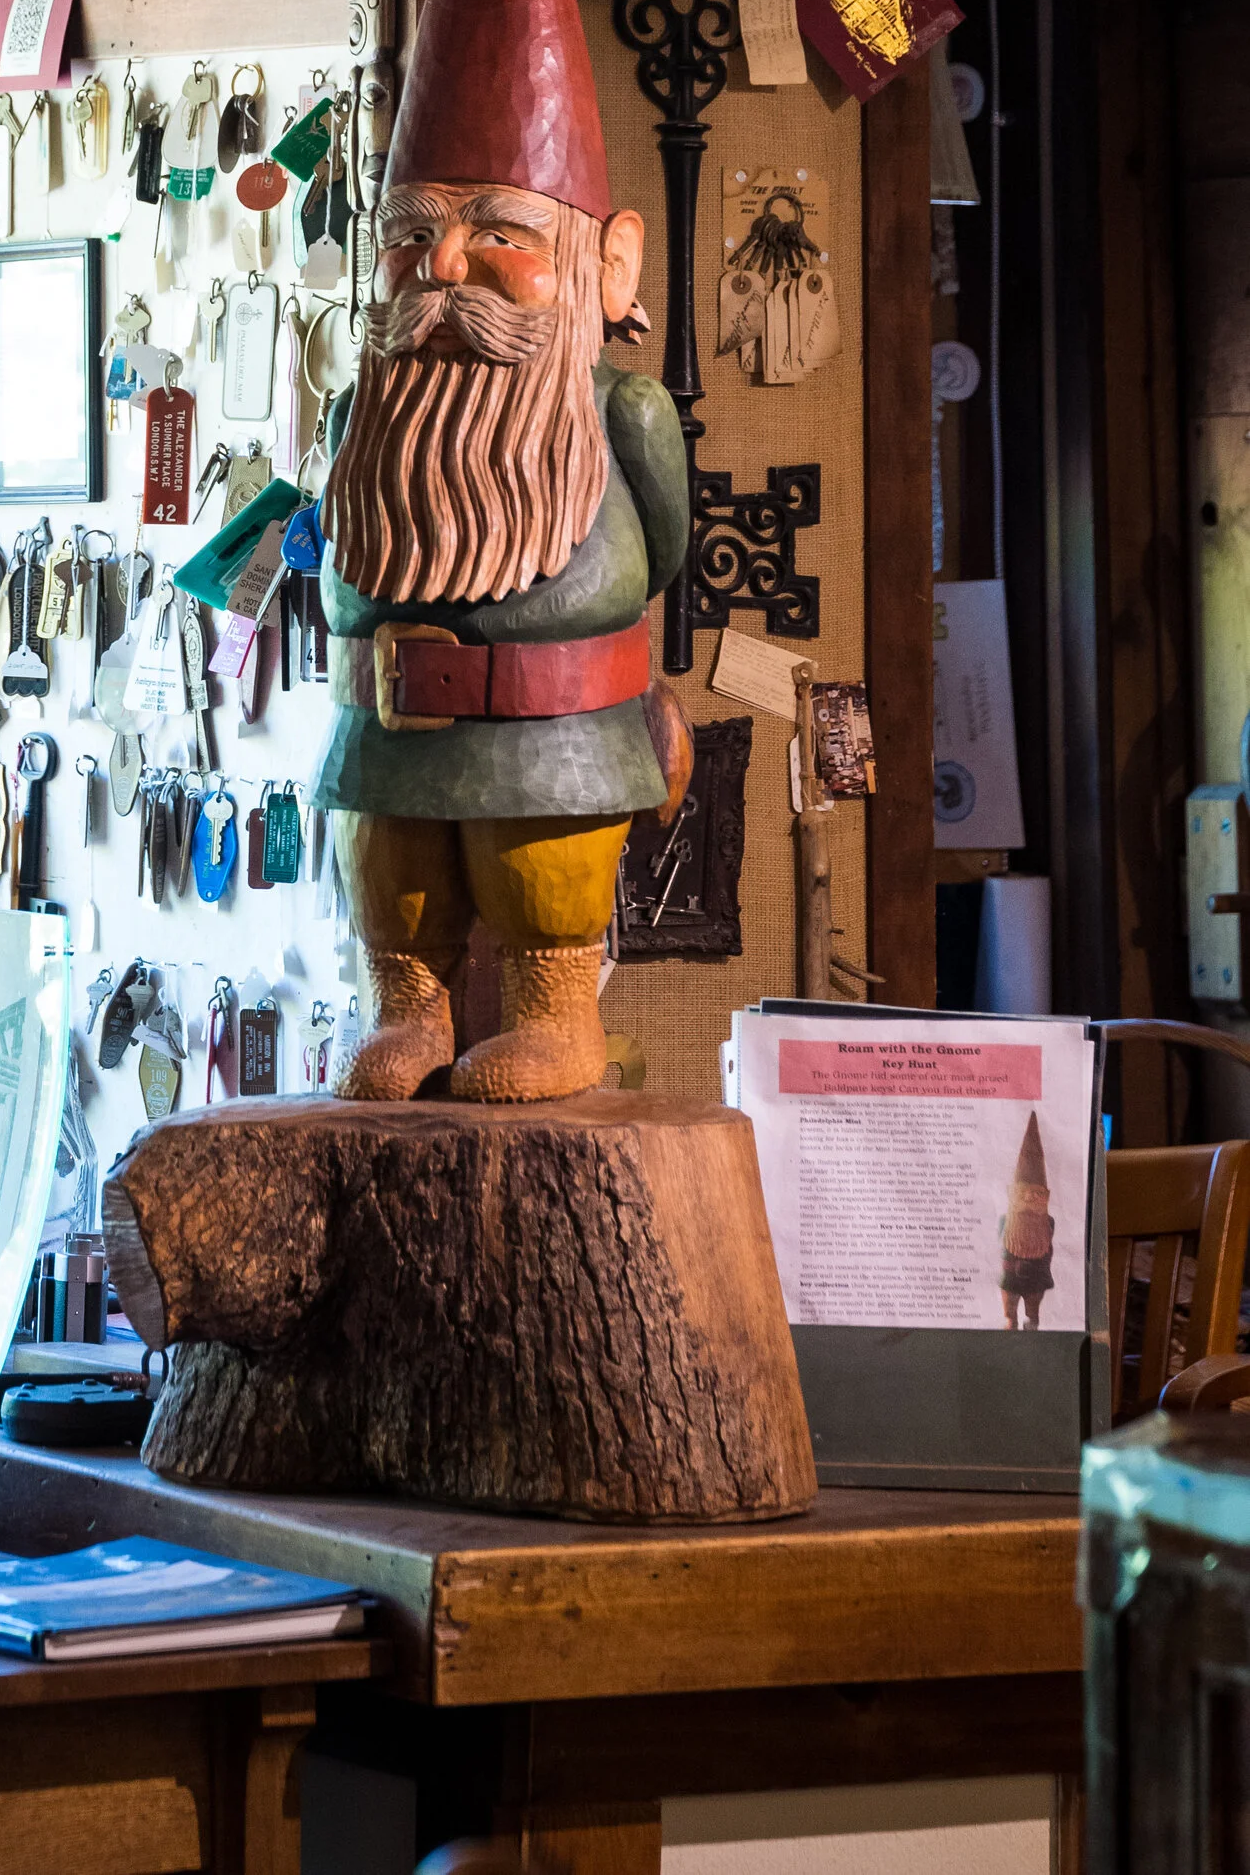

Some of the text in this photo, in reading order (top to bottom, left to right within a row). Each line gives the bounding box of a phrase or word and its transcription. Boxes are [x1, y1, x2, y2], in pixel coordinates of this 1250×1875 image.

[253, 176, 275, 189] 119
[174, 410, 185, 492] THE ALEXANDER
[161, 460, 171, 488] PLACE
[153, 504, 177, 522] 42
[254, 563, 278, 577] SANT
[32, 572, 44, 597] PARK
[243, 596, 263, 610] HOTE
[30, 598, 42, 624] LANE
[244, 606, 269, 620] CASO
[838, 1043, 981, 1056] Roam with the Gnome
[882, 1059, 937, 1070] Key Hunt
[150, 1068, 168, 1084] 109
[812, 1071, 830, 1080] The
[833, 1070, 867, 1081] Gnome
[890, 1074, 913, 1082] some
[930, 1074, 947, 1082] our
[951, 1074, 975, 1083] most
[823, 1083, 868, 1094] Baldpate
[898, 1085, 920, 1094] Can
[921, 1087, 940, 1096] you
[942, 1085, 963, 1095] find
[966, 1086, 997, 1096] them?
